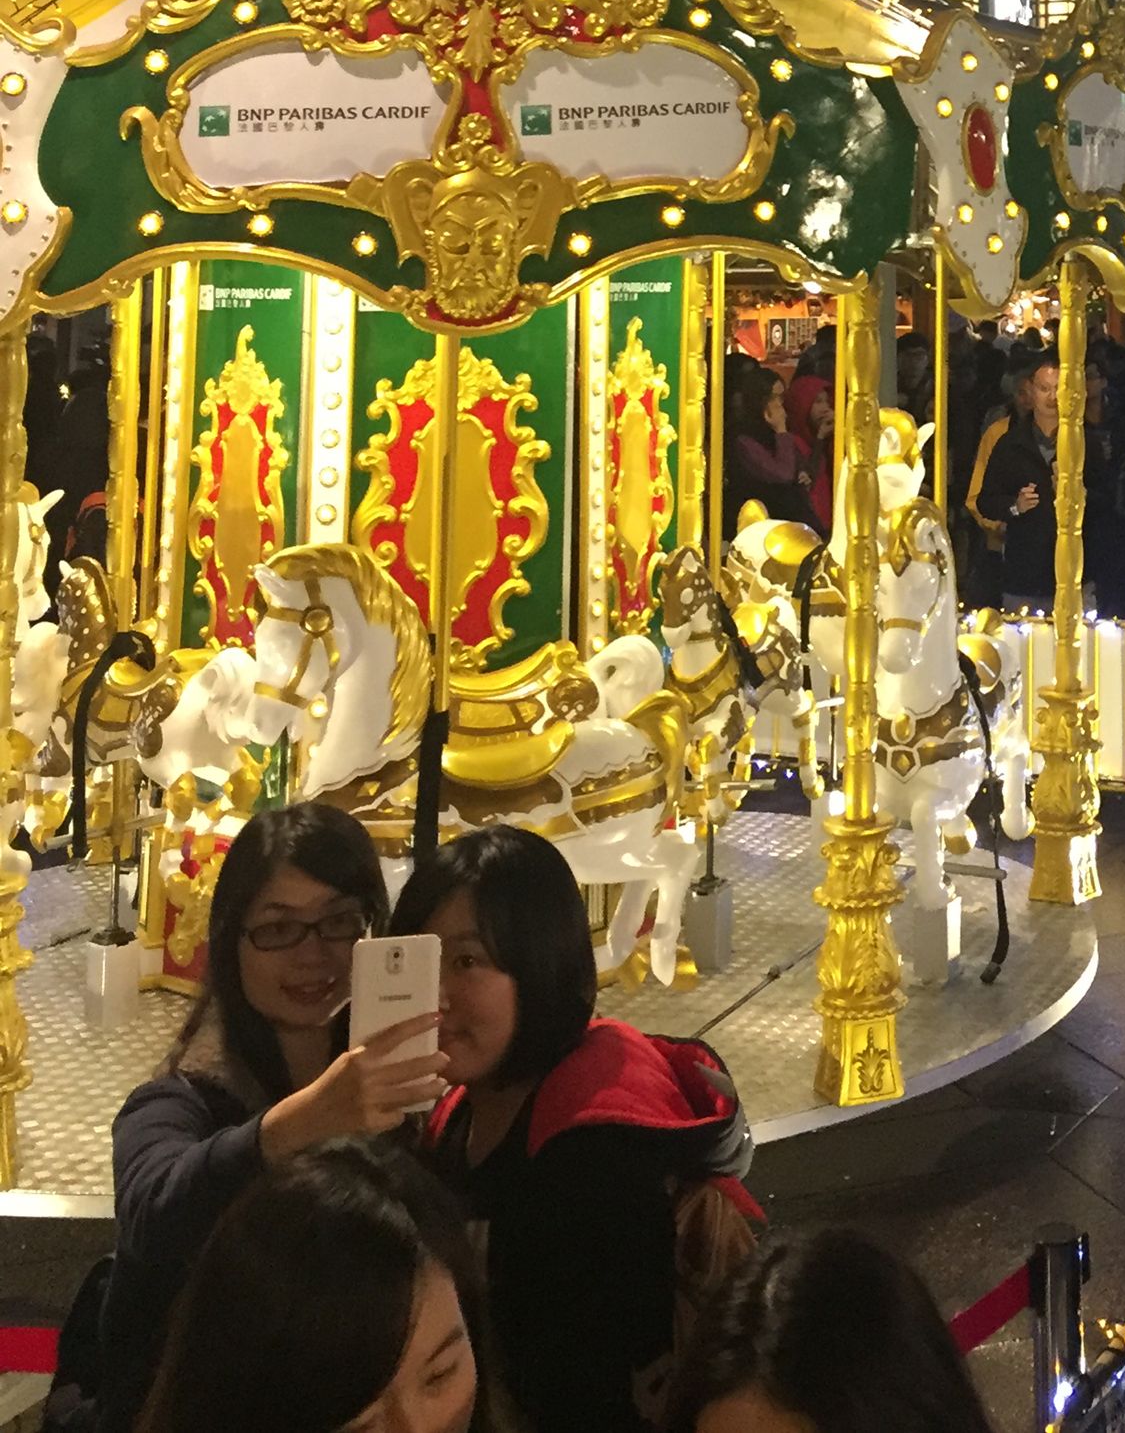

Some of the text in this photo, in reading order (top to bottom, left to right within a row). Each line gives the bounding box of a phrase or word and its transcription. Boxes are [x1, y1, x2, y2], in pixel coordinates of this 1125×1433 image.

[237, 105, 431, 122] BNP PARIBAS CARDIF
[558, 101, 730, 120] BNP PARIBAS CARDIF
